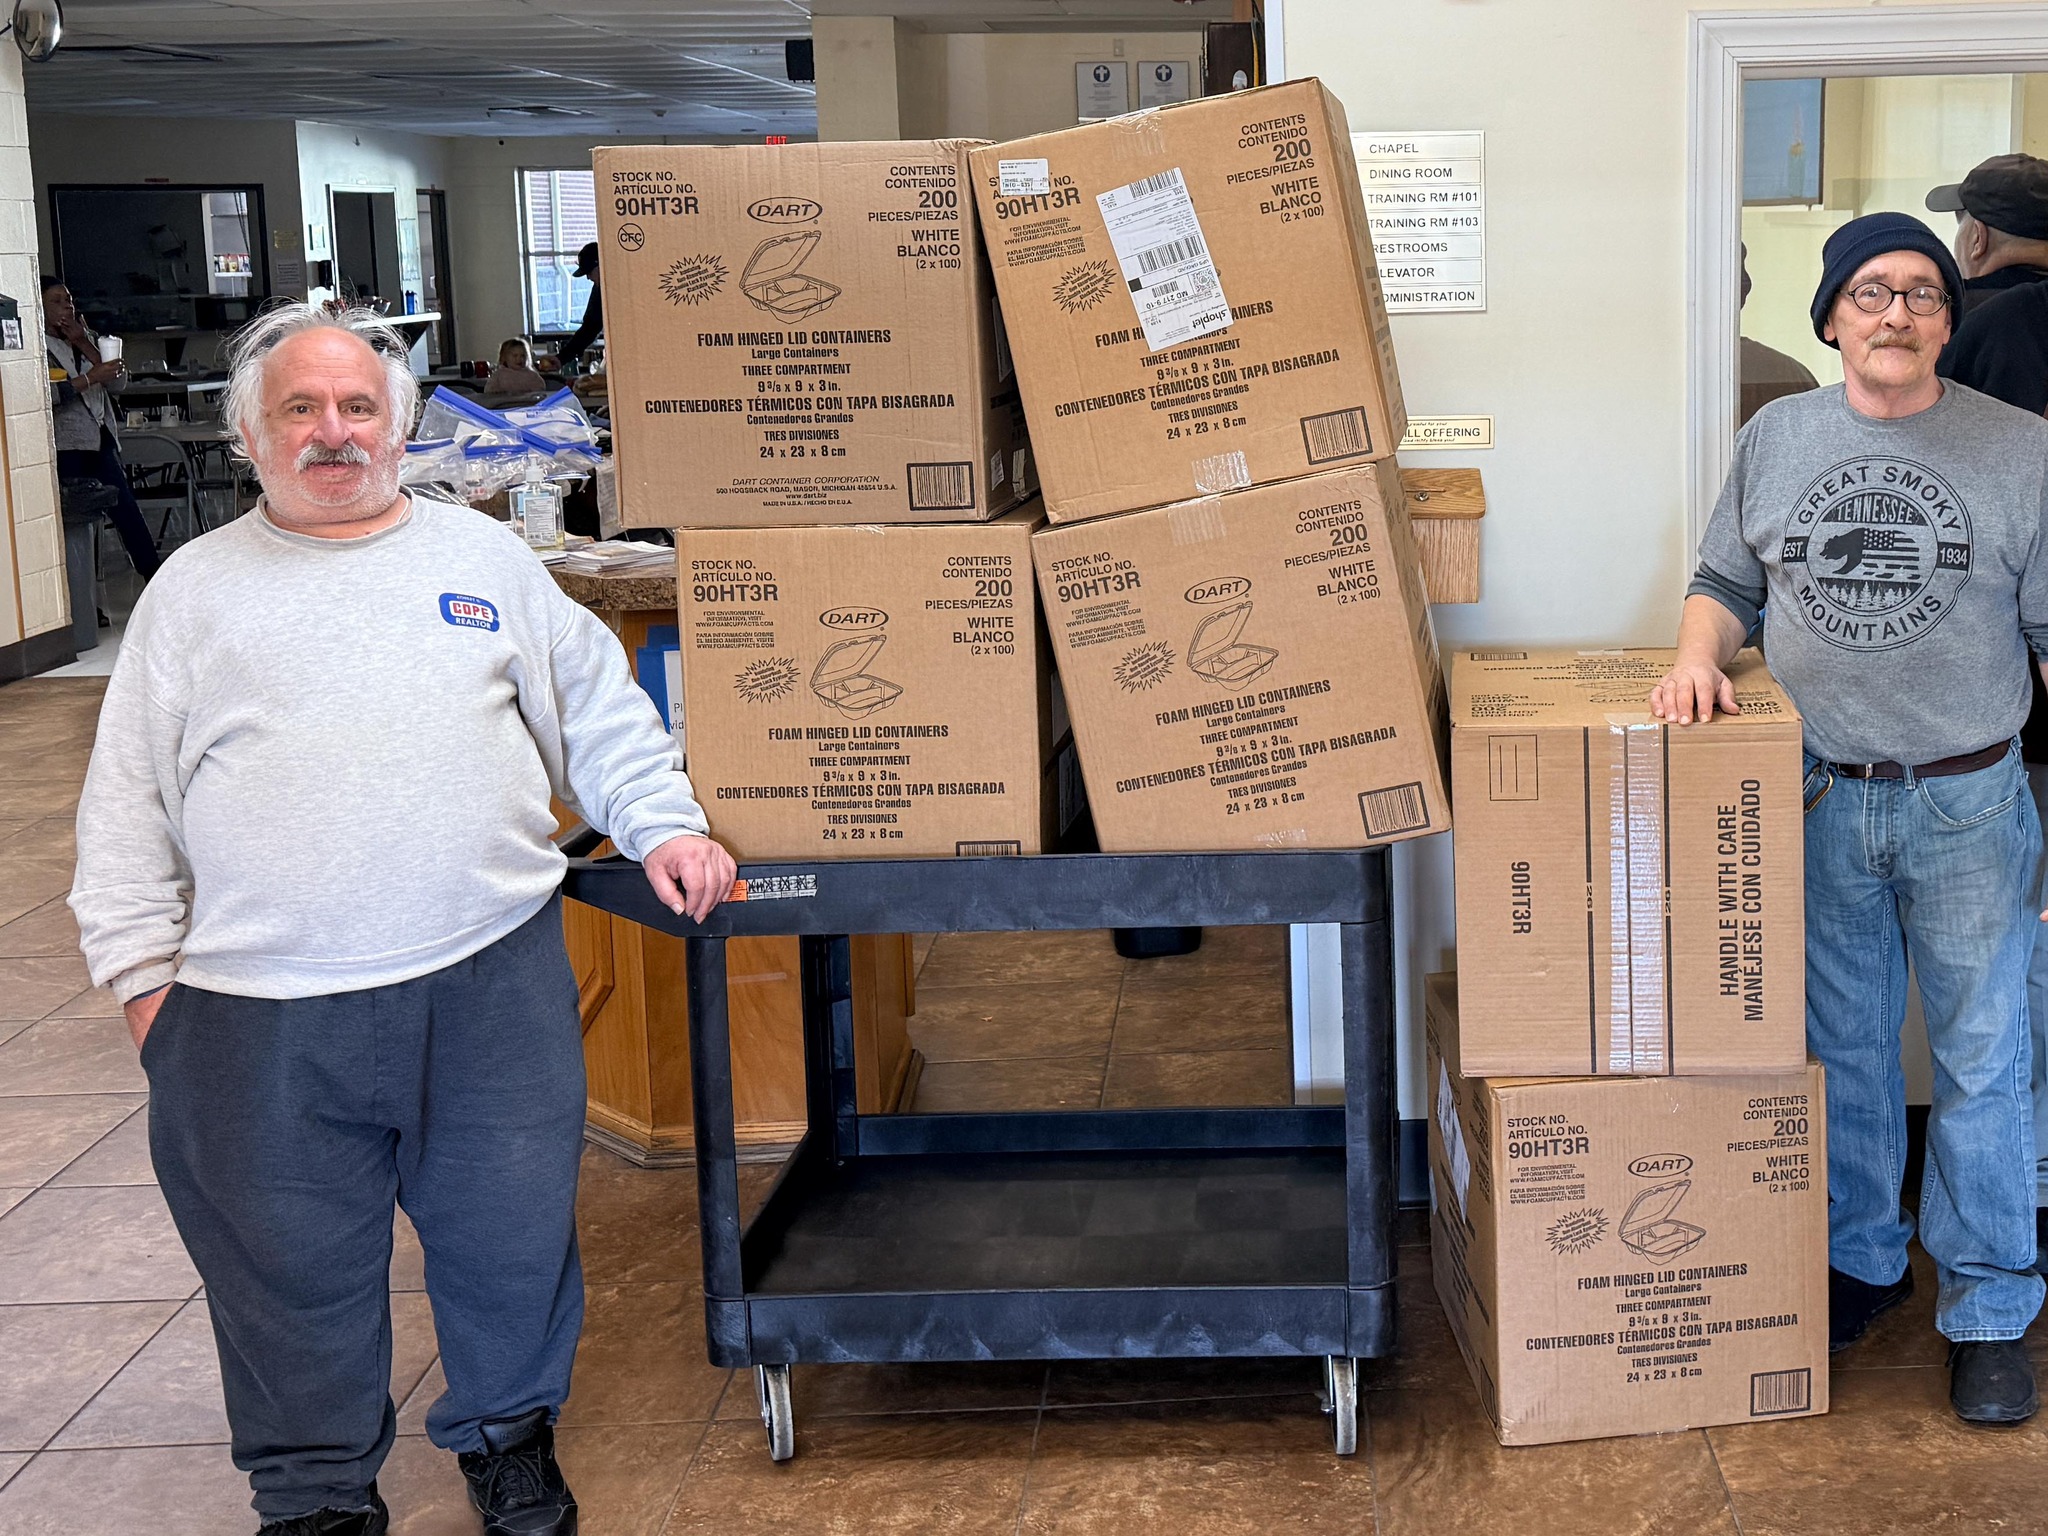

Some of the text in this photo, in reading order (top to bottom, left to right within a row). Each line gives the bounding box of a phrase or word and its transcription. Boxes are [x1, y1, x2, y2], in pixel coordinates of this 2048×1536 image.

[1242, 114, 1305, 135] CONTENTS
[1238, 126, 1307, 148] CONTENIDO
[1273, 139, 1311, 162] 200
[1370, 144, 1419, 153] CHAPEL
[613, 171, 676, 182] STOCK NO.
[890, 166, 955, 176] CONTENTS
[1227, 159, 1314, 184] PIECES/PIEZAS
[1370, 168, 1452, 179] DINING ROOM
[614, 183, 696, 195] ARTÍCULO NO.
[885, 178, 956, 188] CONTENIDO
[1054, 176, 1074, 187] NO.
[1271, 176, 1319, 196] WHITE
[919, 190, 957, 208] 200
[996, 188, 1081, 219] 90HT3R
[1260, 192, 1321, 214] BLANCO
[1368, 192, 1478, 204] TRAINING RM #101
[615, 197, 699, 216] 90HT3R
[755, 204, 812, 218] DART
[868, 211, 958, 221] PIECES/PIEZAS
[1369, 217, 1478, 228] TRAINING RM #103
[911, 229, 959, 241] WHITE
[897, 244, 960, 257] BLANCO
[1373, 243, 1448, 253] RESTROOMS
[1380, 268, 1435, 278] LEVATOR
[1383, 291, 1475, 303] DMINISTRATION
[1192, 309, 1226, 329] shoplet
[1232, 301, 1273, 321] AINERS
[698, 330, 891, 346] FOAM HINGED LID CONTAINERS
[1096, 330, 1130, 347] FOAM
[752, 347, 839, 360] Large Containers
[742, 364, 851, 376] THREE COMPARTMENT
[1055, 349, 1339, 417] CONTENEDORES TÉRMICOS CON TAPA BISAGRADA
[645, 394, 954, 413] CONTENEDORES TÉRMICOS CON TAPA BISAGRADA
[747, 413, 853, 424] Contenedores Grandes
[764, 429, 839, 441] TRES DIVISIONES
[1424, 428, 1480, 437] OFFERING
[815, 476, 879, 484] CORPORATION
[1798, 466, 1961, 531] GREAT SMOKY
[1299, 501, 1361, 521] CONTENTS
[1836, 495, 1913, 524] TENNESSEE
[1296, 512, 1364, 533] CONTENIDO
[1330, 524, 1367, 546] 200
[1285, 543, 1370, 568] PIECES/PIEZAS
[1783, 542, 1804, 557] EST.
[1940, 548, 1968, 565] 1934
[692, 560, 756, 571] STOCK NO.
[948, 556, 1011, 566] CONTENTS
[1052, 552, 1113, 571] STOCK NO.
[693, 570, 776, 582] ARTÍCULO NO.
[943, 568, 1011, 578] CONTENIDO
[1056, 560, 1135, 583] ARTÍCULO NO.
[1328, 560, 1375, 579] WHITE
[694, 584, 778, 602] 90HT3R
[975, 580, 1012, 596] 200
[1058, 571, 1141, 602] 90HT3R
[1192, 581, 1244, 602] DART
[1317, 575, 1378, 596] BLANCO
[453, 603, 489, 619] COPE
[926, 599, 1013, 609] PIECES/PIEZAS
[827, 612, 882, 626] DART
[1800, 585, 1941, 641] MOUNTAINS
[456, 617, 491, 629] REALTOR
[967, 617, 1013, 628] WHITE
[953, 631, 1014, 643] BLANCO
[1156, 680, 1331, 725] FOAM HINGED LID CONTAINERS
[769, 725, 948, 740] FOAM HINGED LID CONTAINERS
[1116, 727, 1397, 793] CONTENEDORES TÉRMICOS CON TAPA BISAGRADA
[717, 782, 1005, 799] CONTENEDORES TÉRMICOS CON TAPA BISAGRADA
[1511, 861, 1532, 934] 90HT3R
[1717, 805, 1739, 995] HANDLE WITH CARE
[1739, 779, 1763, 1021] MANÉJESE CON CUIDADO
[1749, 1095, 1807, 1108] CONTENTS
[1508, 1115, 1568, 1128] STOCK NO.
[1744, 1107, 1808, 1120] CONTENIDO
[1508, 1125, 1587, 1139] ARTÍCULO NO.
[1774, 1118, 1808, 1136] 200
[1509, 1137, 1589, 1159] 90HT3R
[1728, 1137, 1808, 1152] PIECES/PIEZAS
[1635, 1159, 1687, 1174] DART
[1766, 1154, 1809, 1167] WHITE
[1753, 1167, 1809, 1183] BLANCO
[1578, 1263, 1747, 1290] FOAM HINGED LID CONTAINERS
[1527, 1314, 1797, 1350] CONTENEDORES TÉRMICOS CON TAPA BISAGRADA
